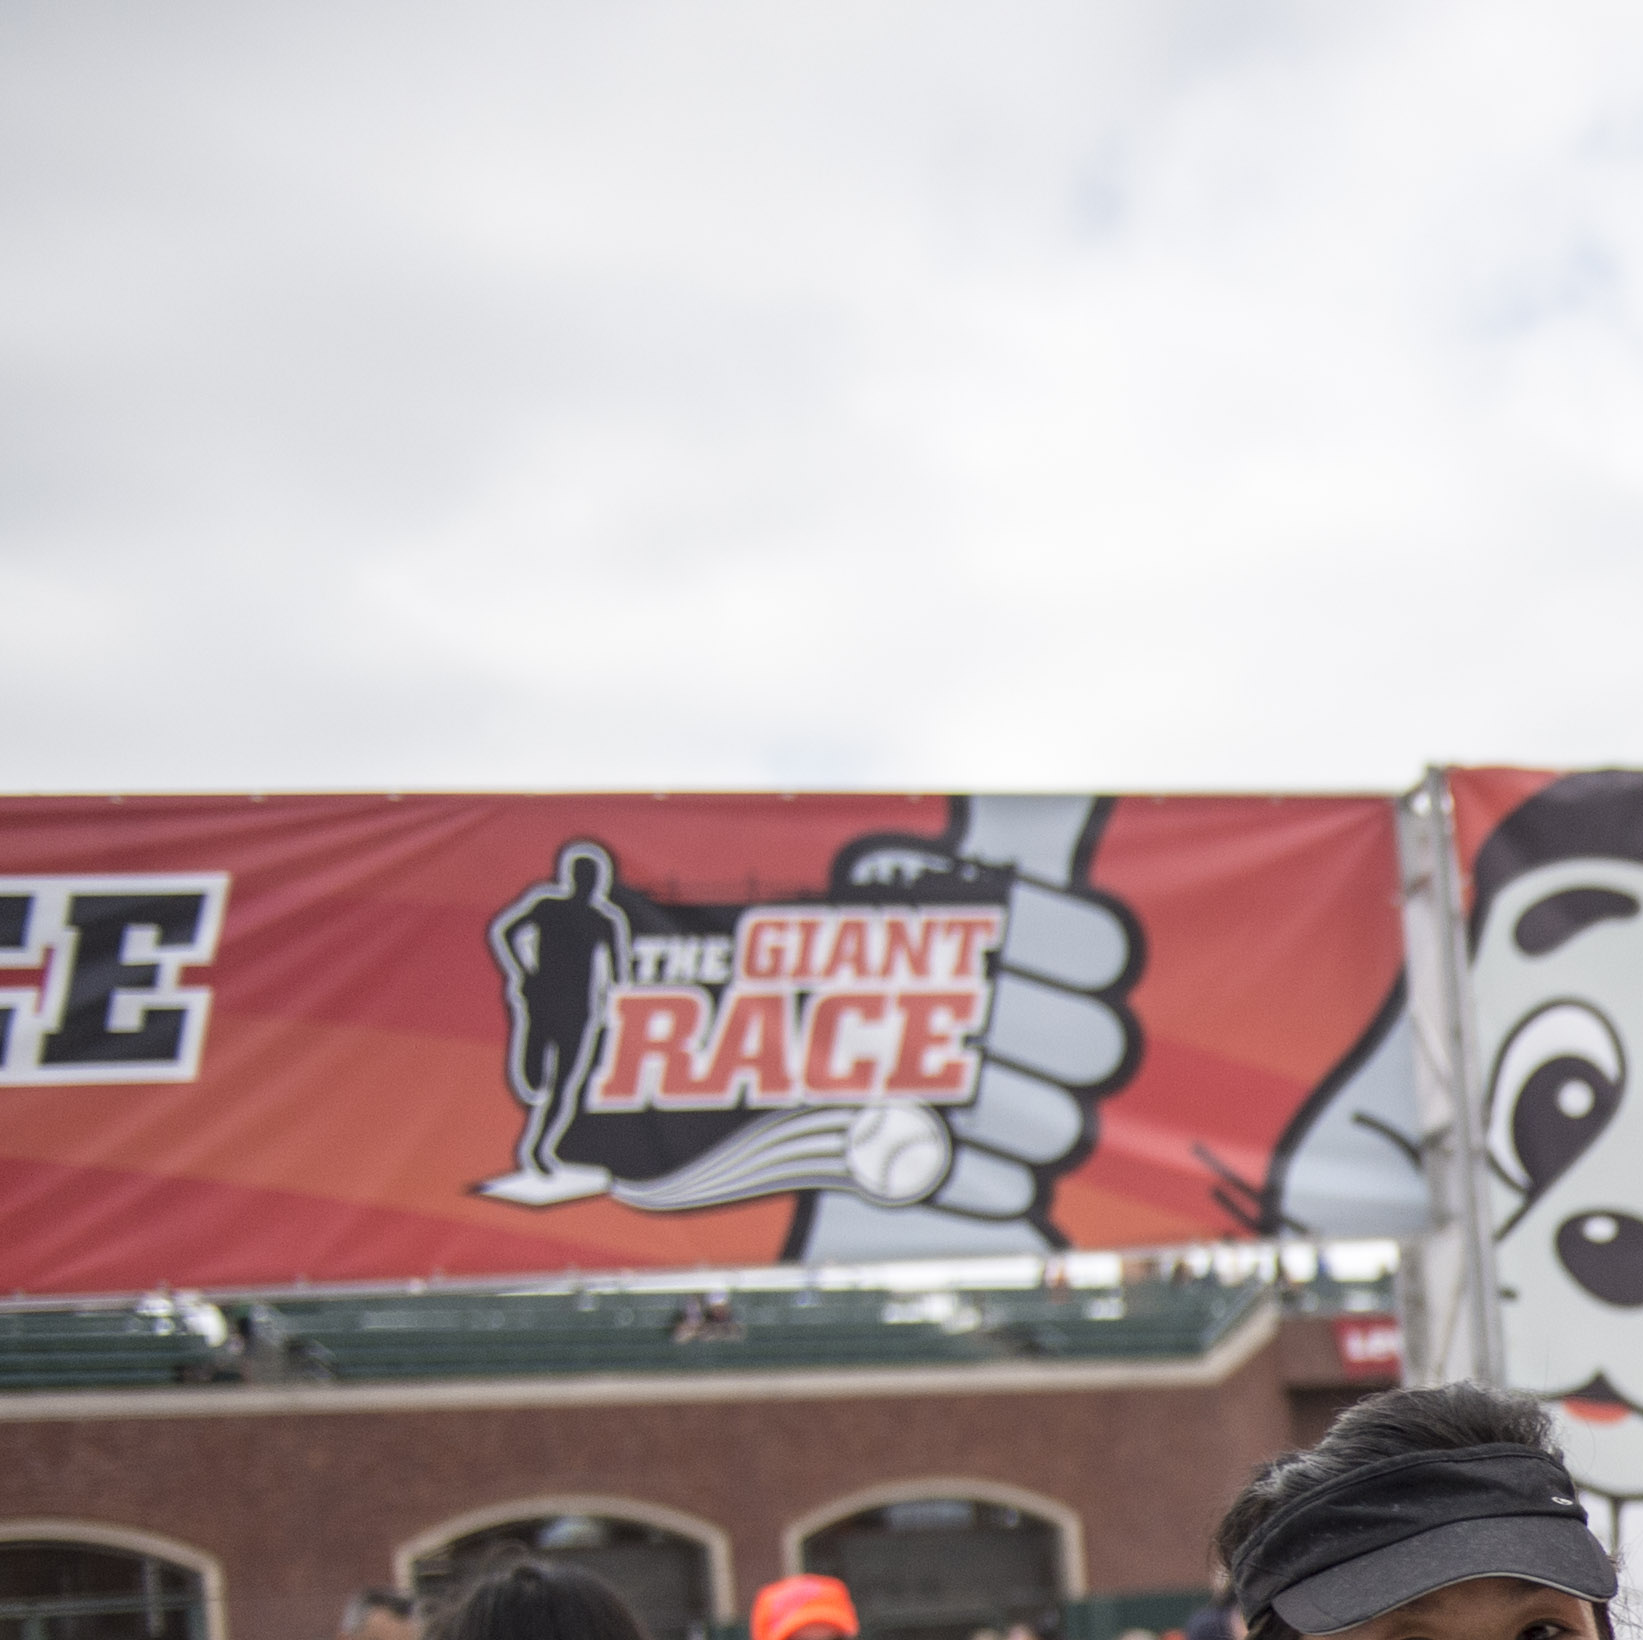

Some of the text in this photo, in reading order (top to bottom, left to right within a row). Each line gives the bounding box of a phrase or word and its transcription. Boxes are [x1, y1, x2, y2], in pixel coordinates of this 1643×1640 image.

[633, 910, 1002, 983] THE GIANT
[592, 985, 985, 1108] RACE
